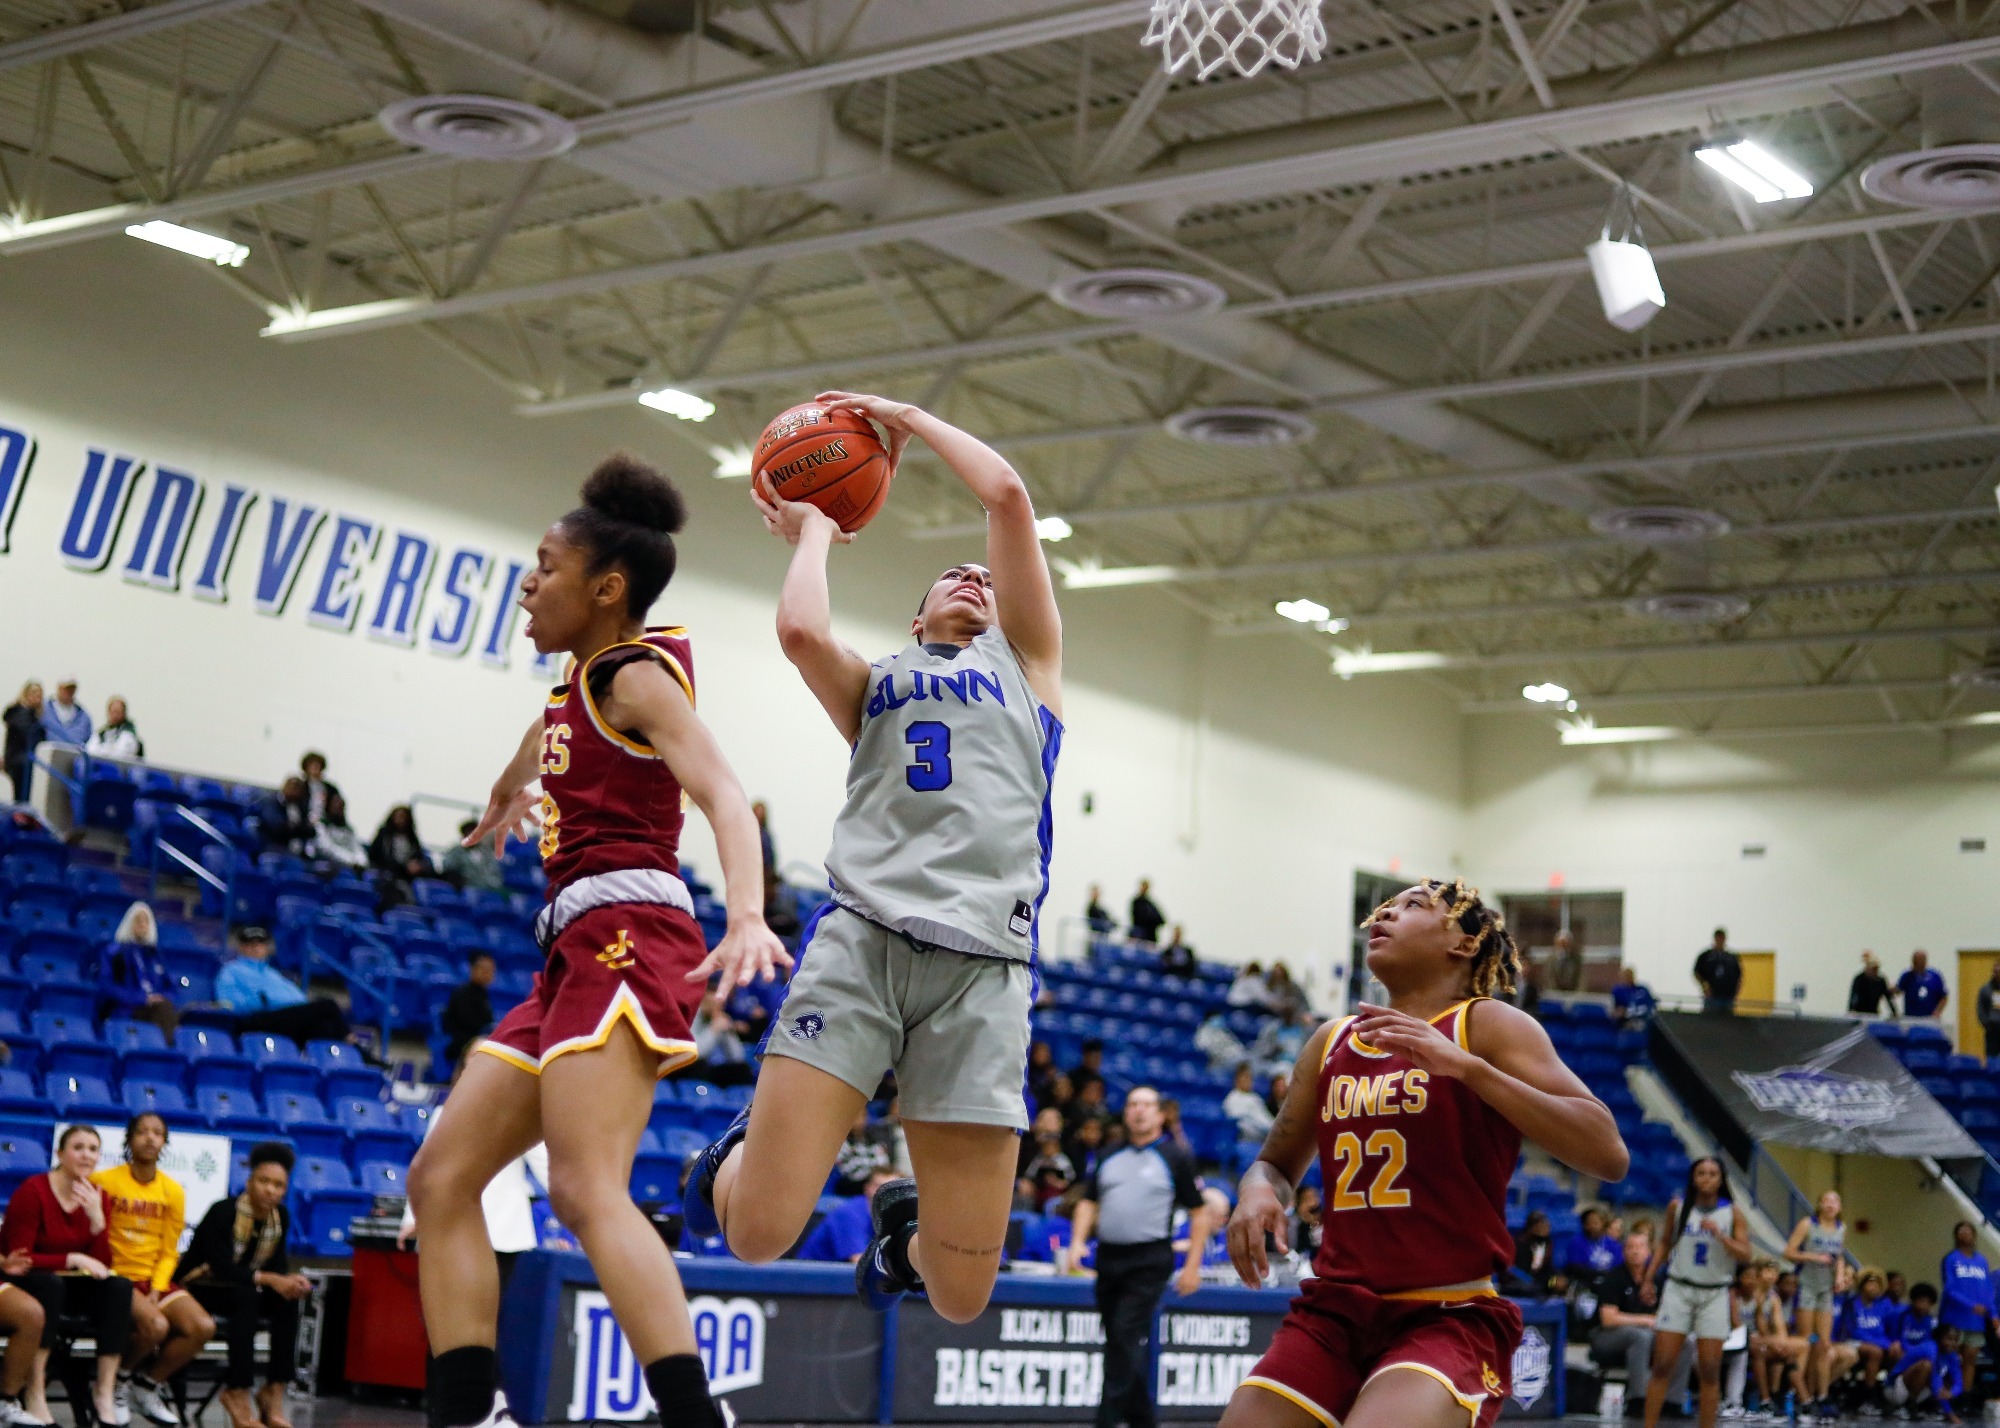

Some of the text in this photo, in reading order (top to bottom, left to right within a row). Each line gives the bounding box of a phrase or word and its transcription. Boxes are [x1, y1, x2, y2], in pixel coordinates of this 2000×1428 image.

[57, 445, 560, 680] UNIVERSI
[867, 669, 1006, 719] BLINN
[905, 720, 953, 792] 3
[1321, 1068, 1429, 1123] JONES
[1333, 1128, 1412, 1211] 22
[567, 1290, 766, 1421] NJAA
[934, 1348, 1105, 1407] BASKETBA
